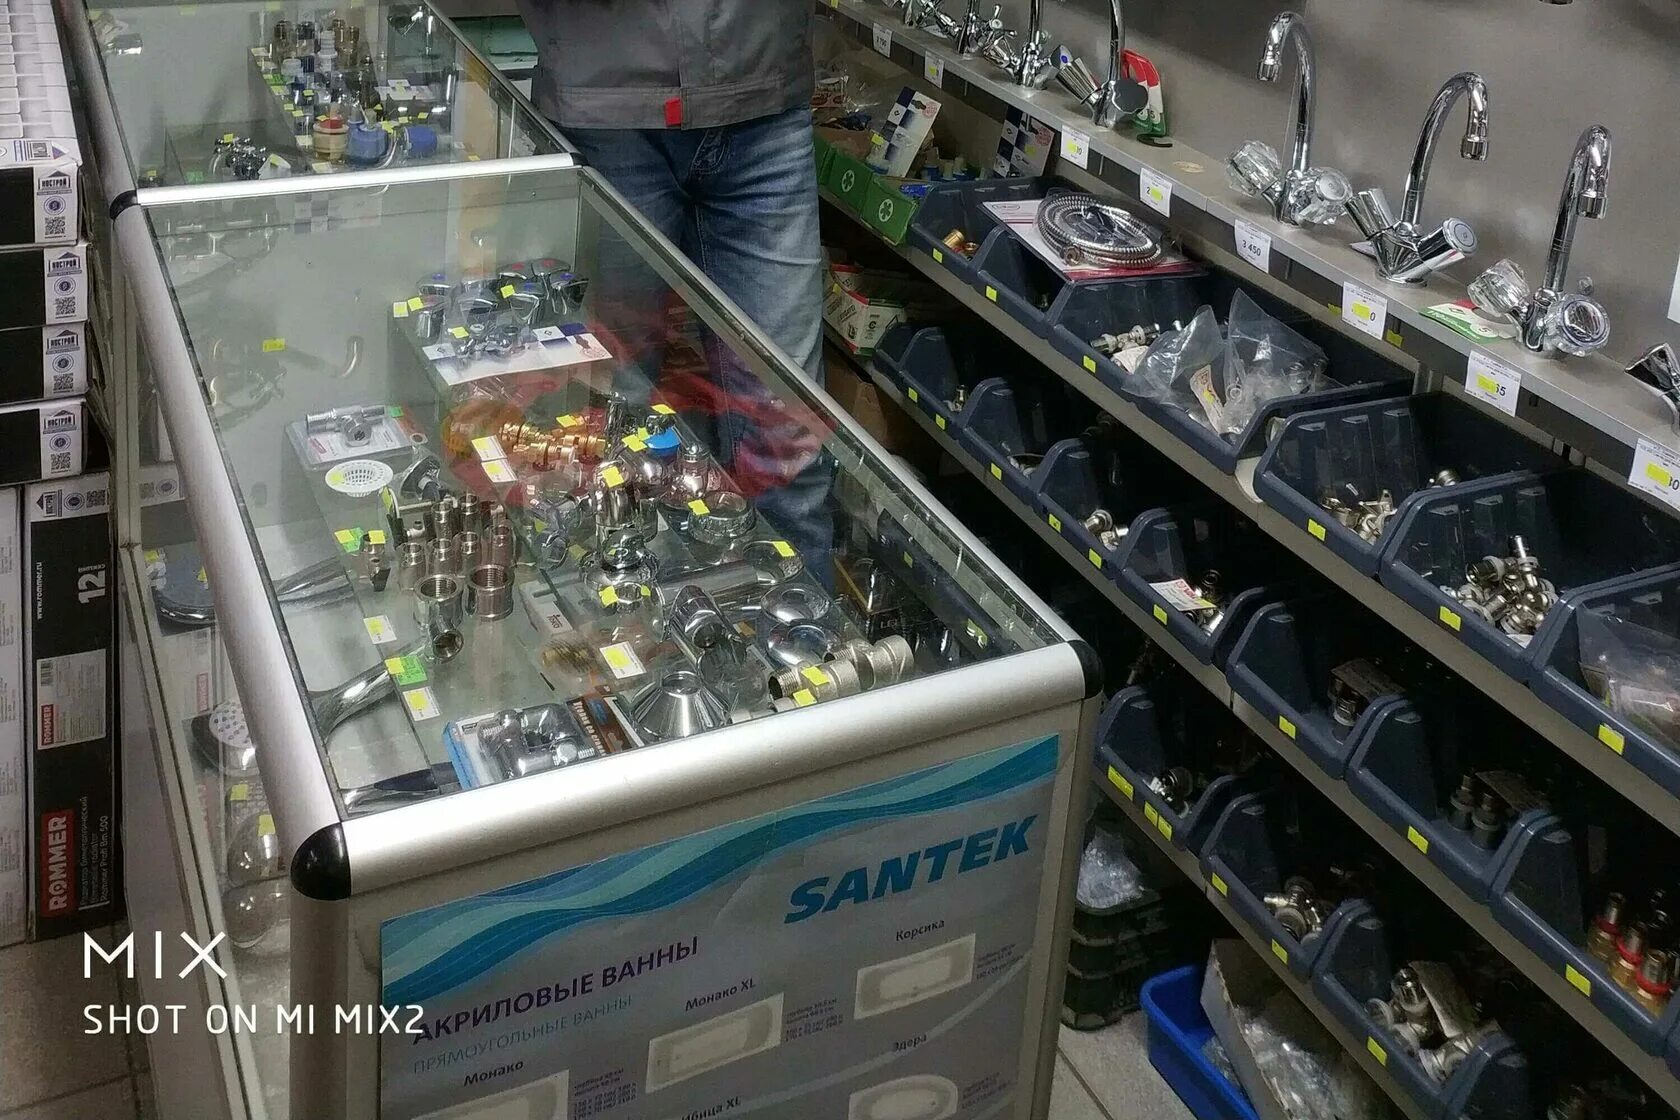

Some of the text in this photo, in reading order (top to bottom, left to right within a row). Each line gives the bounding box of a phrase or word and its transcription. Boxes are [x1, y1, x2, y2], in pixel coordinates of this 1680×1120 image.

[1242, 239, 1262, 257] 3 450
[35, 561, 44, 619] www.rommer.ru
[78, 570, 105, 604] 12
[43, 706, 52, 743] ROMMER
[99, 815, 108, 832] 500
[48, 815, 68, 912] ROMMER
[784, 814, 1038, 924] SANTEK
[895, 919, 945, 942] Корсика
[413, 936, 698, 1046] АКРИЛОВЫЕ ВАННЫ
[685, 977, 757, 1012] Монако XL
[413, 995, 633, 1075] ПРЯМОУГОЛЬНЫЕ ВАННЫ
[463, 1060, 524, 1087] Монако
[725, 1096, 741, 1110] XL
